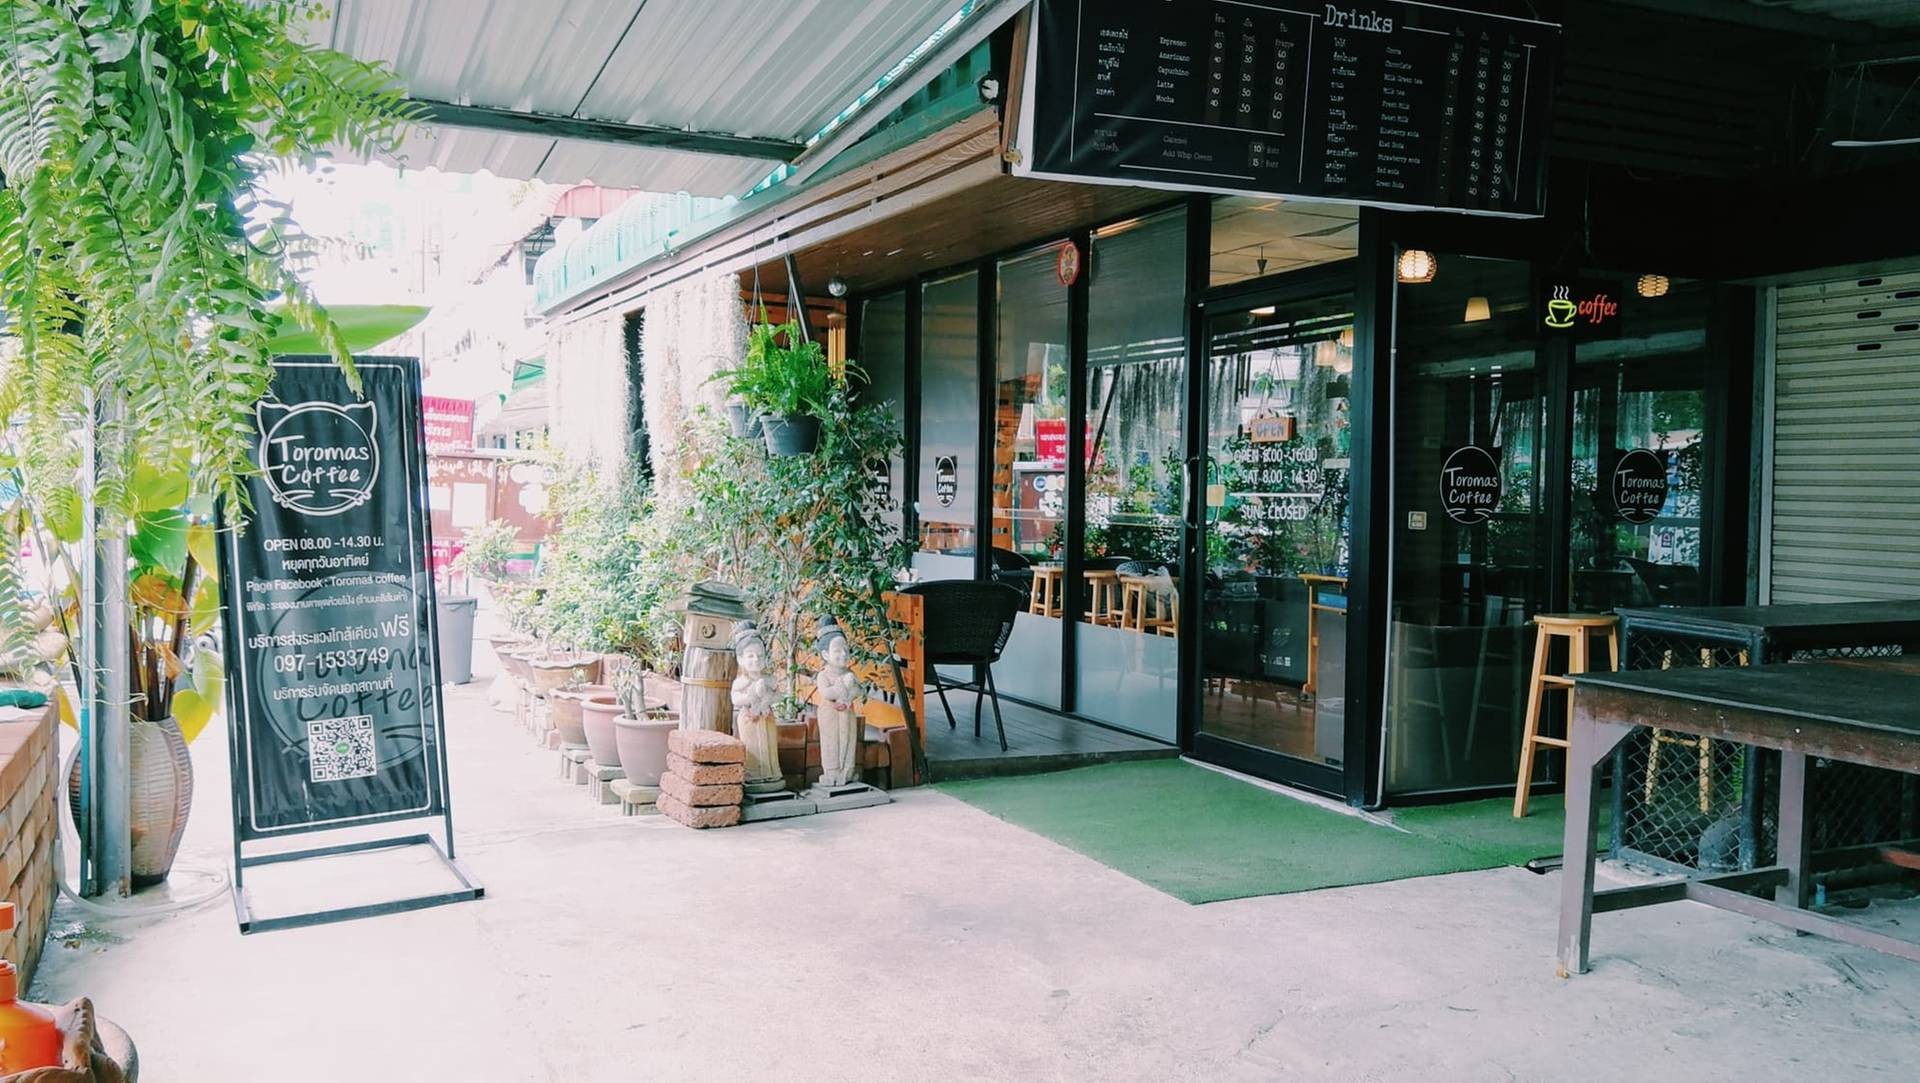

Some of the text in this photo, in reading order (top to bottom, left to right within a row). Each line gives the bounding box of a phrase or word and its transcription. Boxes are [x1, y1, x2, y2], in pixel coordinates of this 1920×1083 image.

[1324, 4, 1393, 33] Drinks
[1214, 41, 1287, 58] 40 50 60
[1243, 54, 1253, 64] 50
[1276, 60, 1285, 70] 60
[1157, 80, 1174, 88] Latte
[1213, 72, 1284, 86] 40 50 60
[1155, 94, 1174, 103] Mocha
[1211, 87, 1283, 101] 40 50 60
[1210, 99, 1282, 119] 40 50 60
[1578, 294, 1617, 324] coffee
[271, 435, 369, 463] Toromas
[1234, 449, 1259, 463] OPEN
[1263, 448, 1283, 462] 8.00
[282, 465, 361, 485] Coffee
[1243, 470, 1259, 484] SAT
[1263, 470, 1282, 483] 8.00
[1445, 467, 1498, 487] Toromas
[1617, 469, 1664, 489] Toromas
[1449, 489, 1492, 504] Coffee
[1620, 490, 1659, 505] Coffee
[1241, 505, 1261, 520] SUN
[1268, 505, 1307, 520] CLOSED
[264, 539, 298, 551] OPEN
[300, 537, 331, 550] 08.00
[373, 538, 385, 547] น.
[282, 553, 369, 573] หยุดทุกวันอาทิตย์
[246, 581, 272, 593] Page
[274, 578, 322, 591] Facebook
[331, 575, 373, 587] Toromas
[375, 573, 406, 584] coffee
[381, 614, 410, 637] ฟรี
[274, 646, 389, 672] 097-1533749
[273, 672, 394, 700] บริการรับจัดนอกสถานที่
